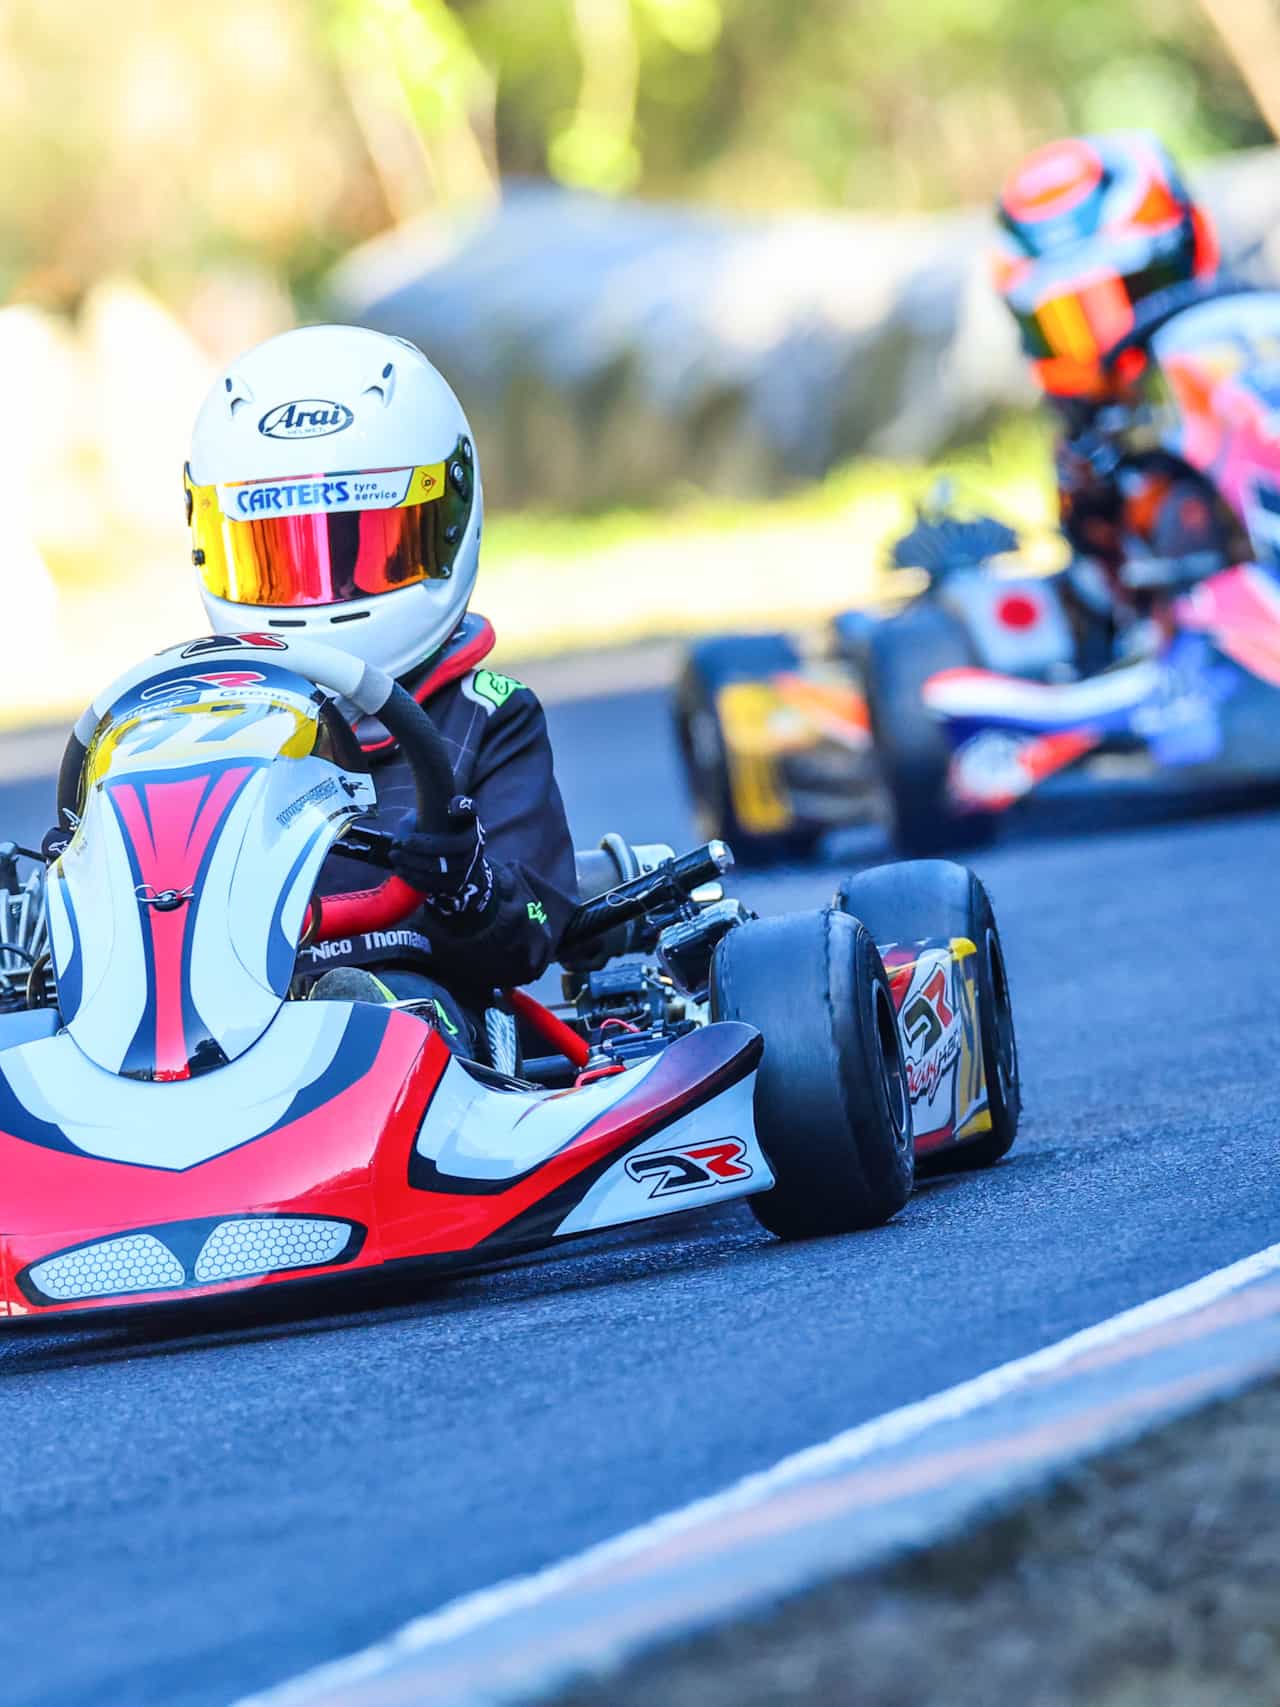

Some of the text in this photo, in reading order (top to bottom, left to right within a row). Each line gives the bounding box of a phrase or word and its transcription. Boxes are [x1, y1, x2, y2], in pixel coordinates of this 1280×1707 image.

[265, 404, 342, 432] Arai
[237, 482, 350, 513] CARTER'S
[354, 482, 378, 491] tyre
[355, 490, 398, 501] service
[309, 939, 352, 962] Nico
